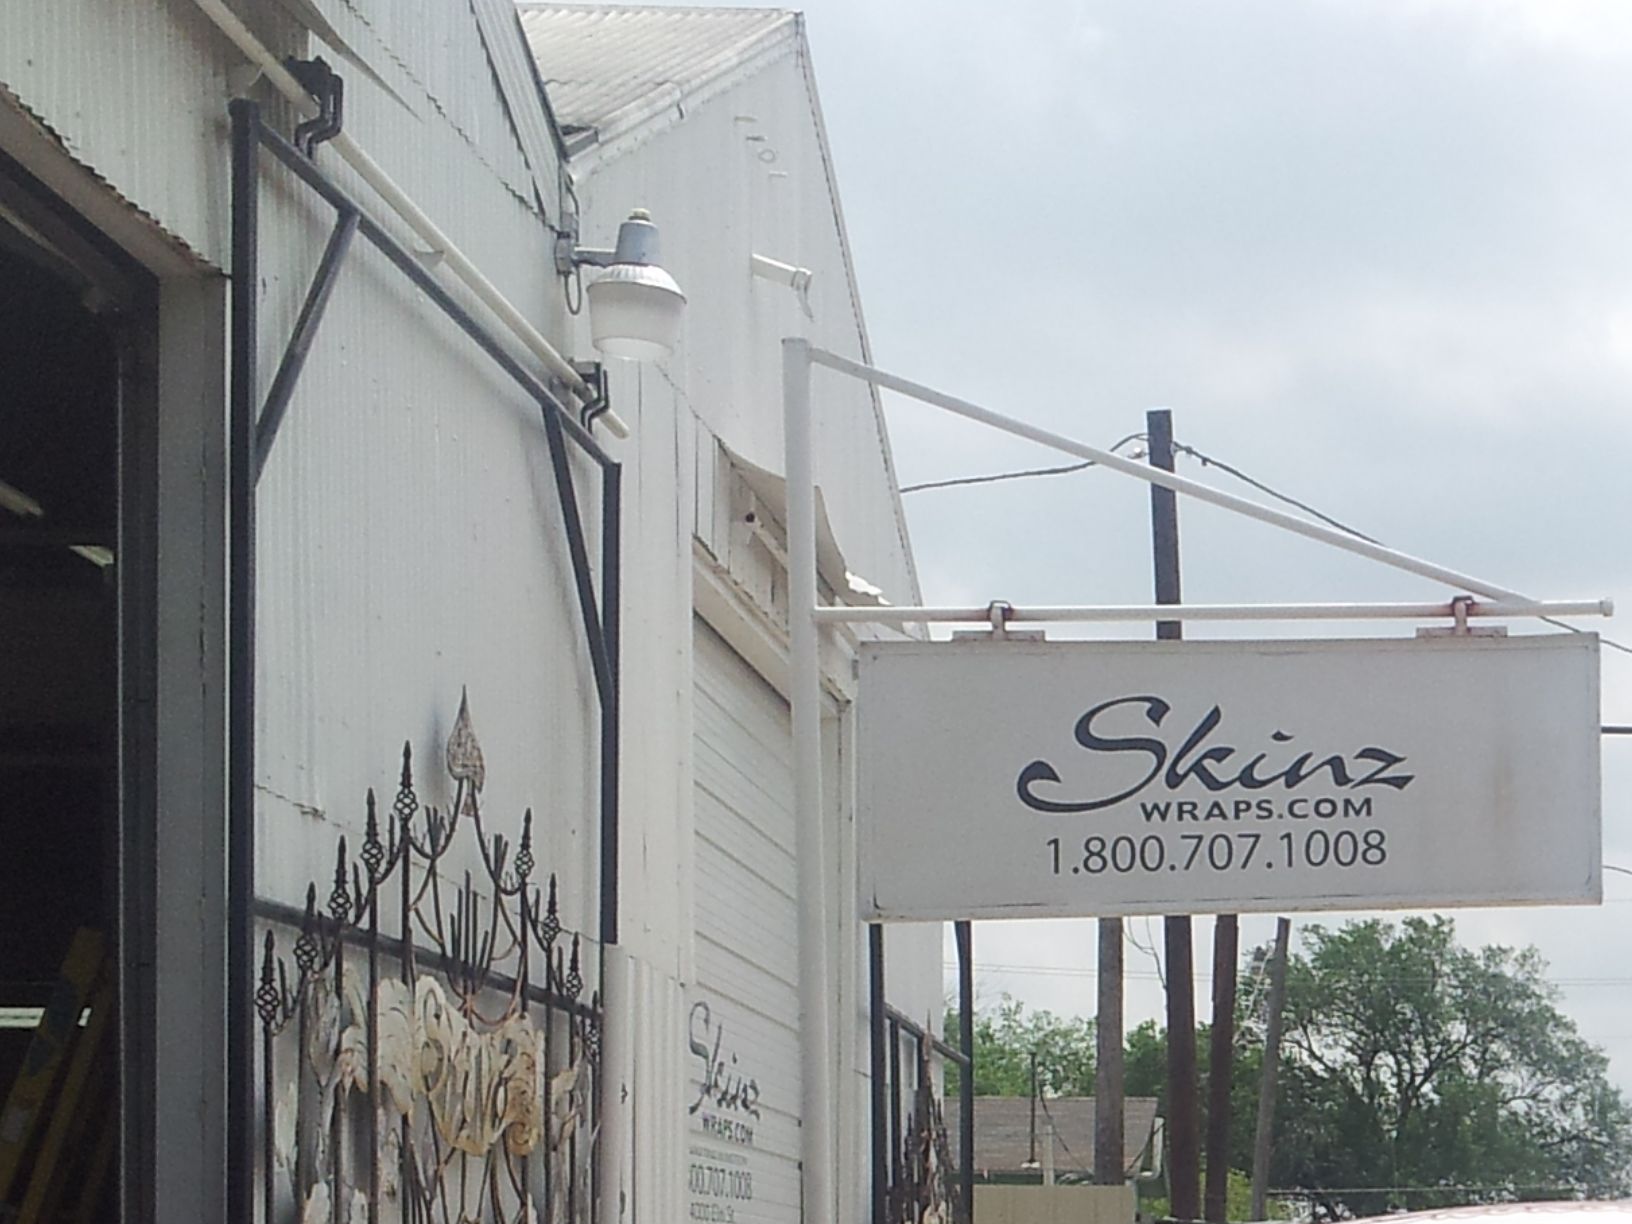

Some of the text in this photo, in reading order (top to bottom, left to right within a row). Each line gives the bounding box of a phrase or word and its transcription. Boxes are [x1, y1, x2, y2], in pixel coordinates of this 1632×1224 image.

[1017, 695, 1415, 813] Skinz
[1140, 797, 1374, 822] WRAPS.COM
[1045, 829, 1388, 875] 1.800.707.1008
